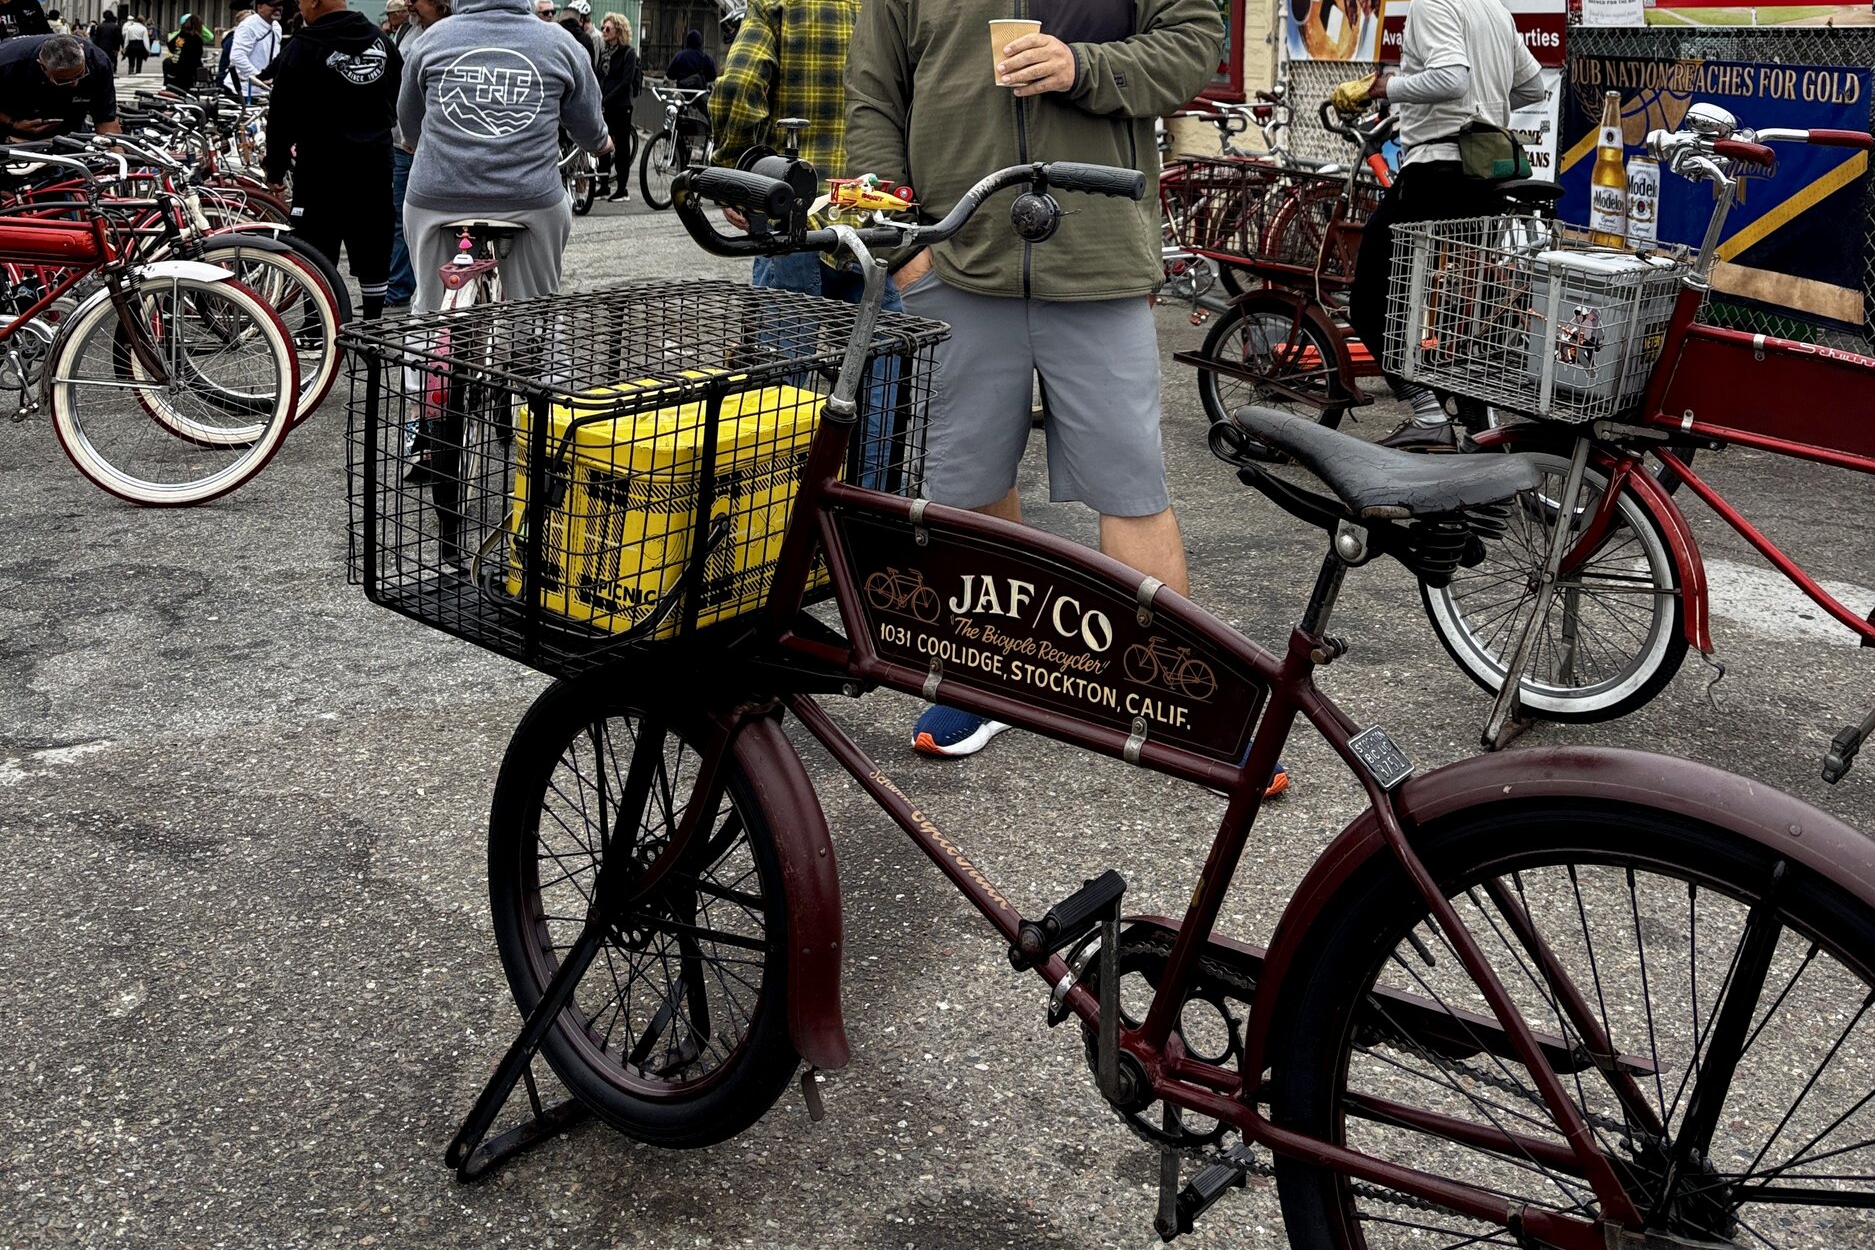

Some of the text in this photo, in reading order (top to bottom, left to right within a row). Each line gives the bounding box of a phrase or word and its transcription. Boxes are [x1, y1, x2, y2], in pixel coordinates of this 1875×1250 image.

[1571, 58, 1861, 105] DUB NATION REACHES FOR GOLD
[598, 578, 657, 605] PICNIC
[949, 574, 1113, 652] JAF/CO
[982, 625, 1037, 656] Bicycle
[880, 622, 1192, 730] 1031 COOLIDGE, STOCKTON, CALIF.
[1355, 731, 1386, 753] STOCKTON
[1365, 741, 1392, 764] BIC LIC
